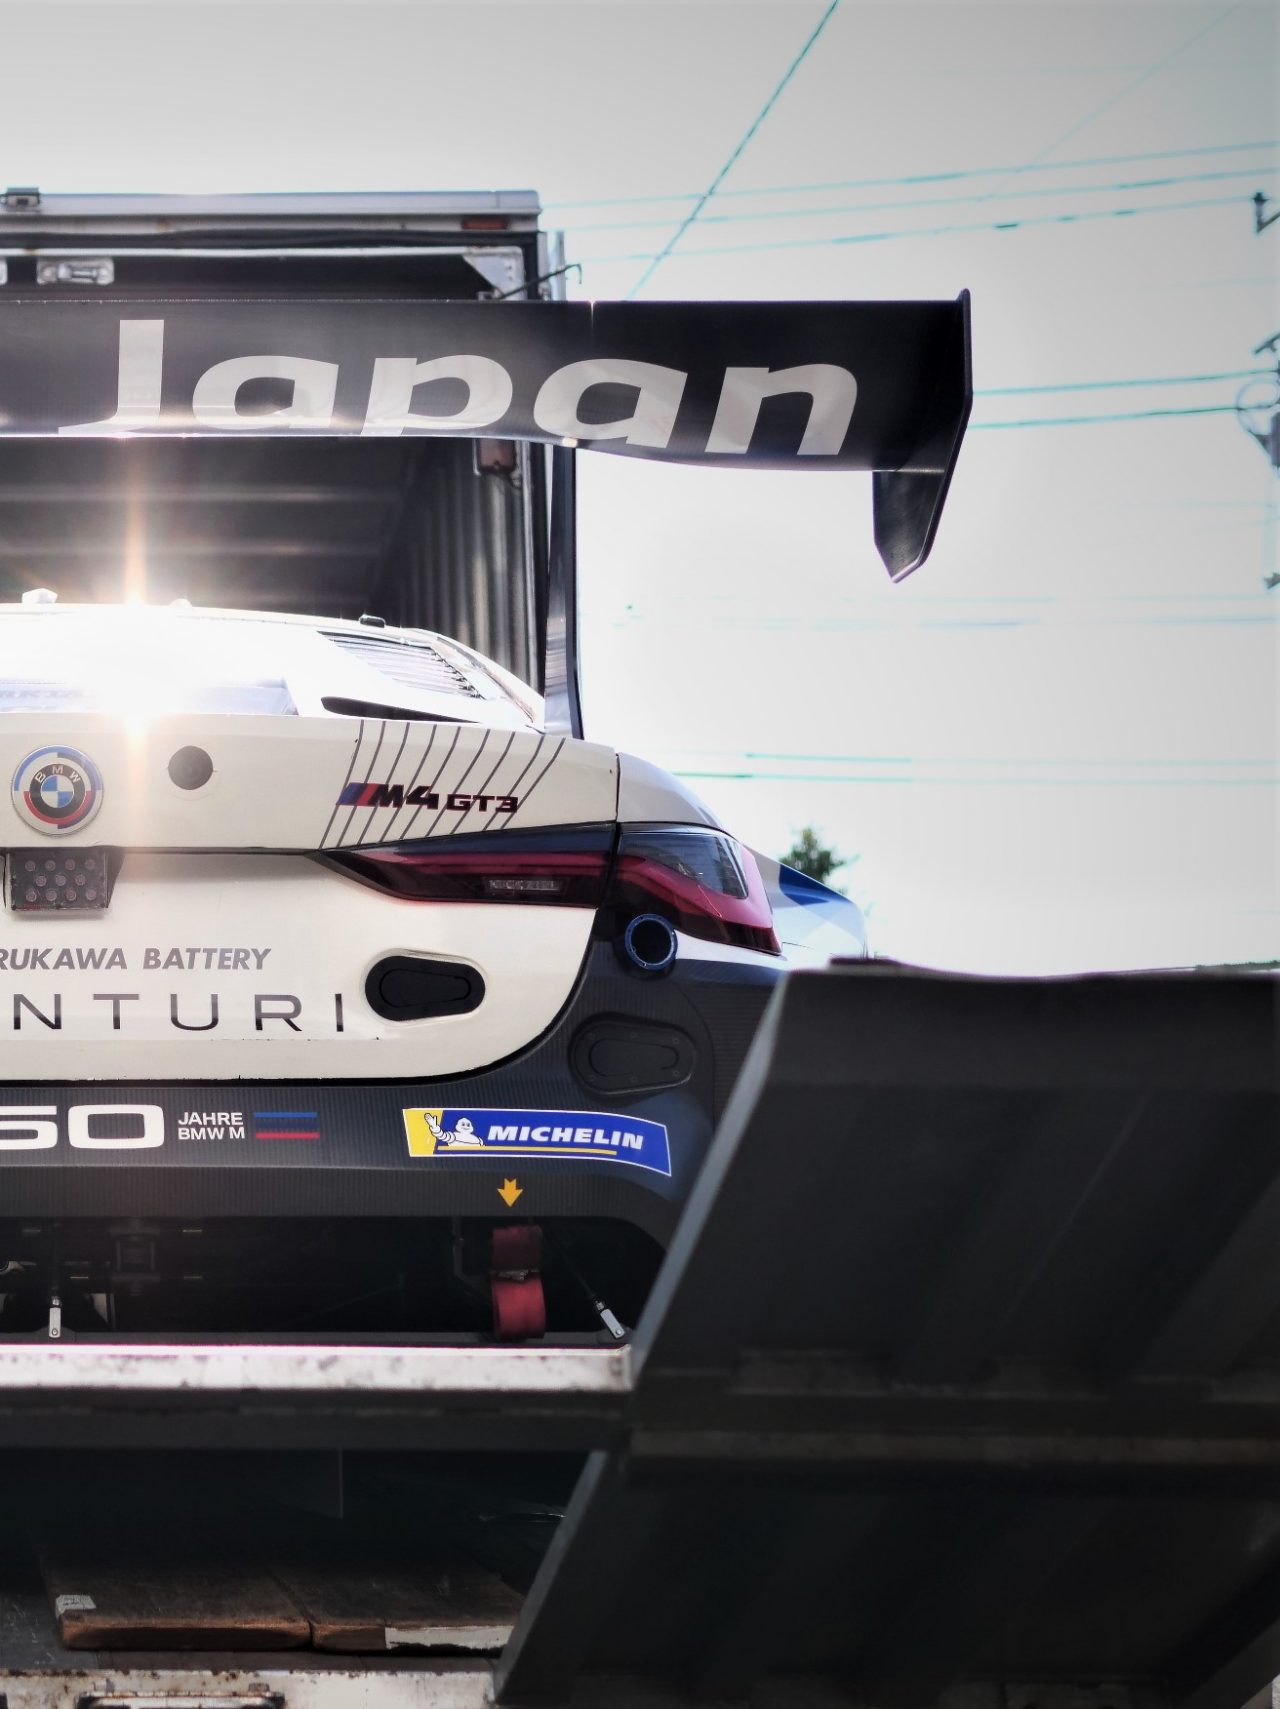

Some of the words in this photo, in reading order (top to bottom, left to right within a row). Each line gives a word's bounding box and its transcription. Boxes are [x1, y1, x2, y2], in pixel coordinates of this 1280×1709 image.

[58, 319, 858, 455] Japan
[35, 764, 81, 784] BMW
[447, 793, 519, 813] GT3
[143, 947, 272, 970] BATTERY
[178, 1111, 244, 1126] JAHRE
[178, 1127, 225, 1140] BMW
[228, 1126, 246, 1139] M
[486, 1125, 644, 1150] MICHELIN
